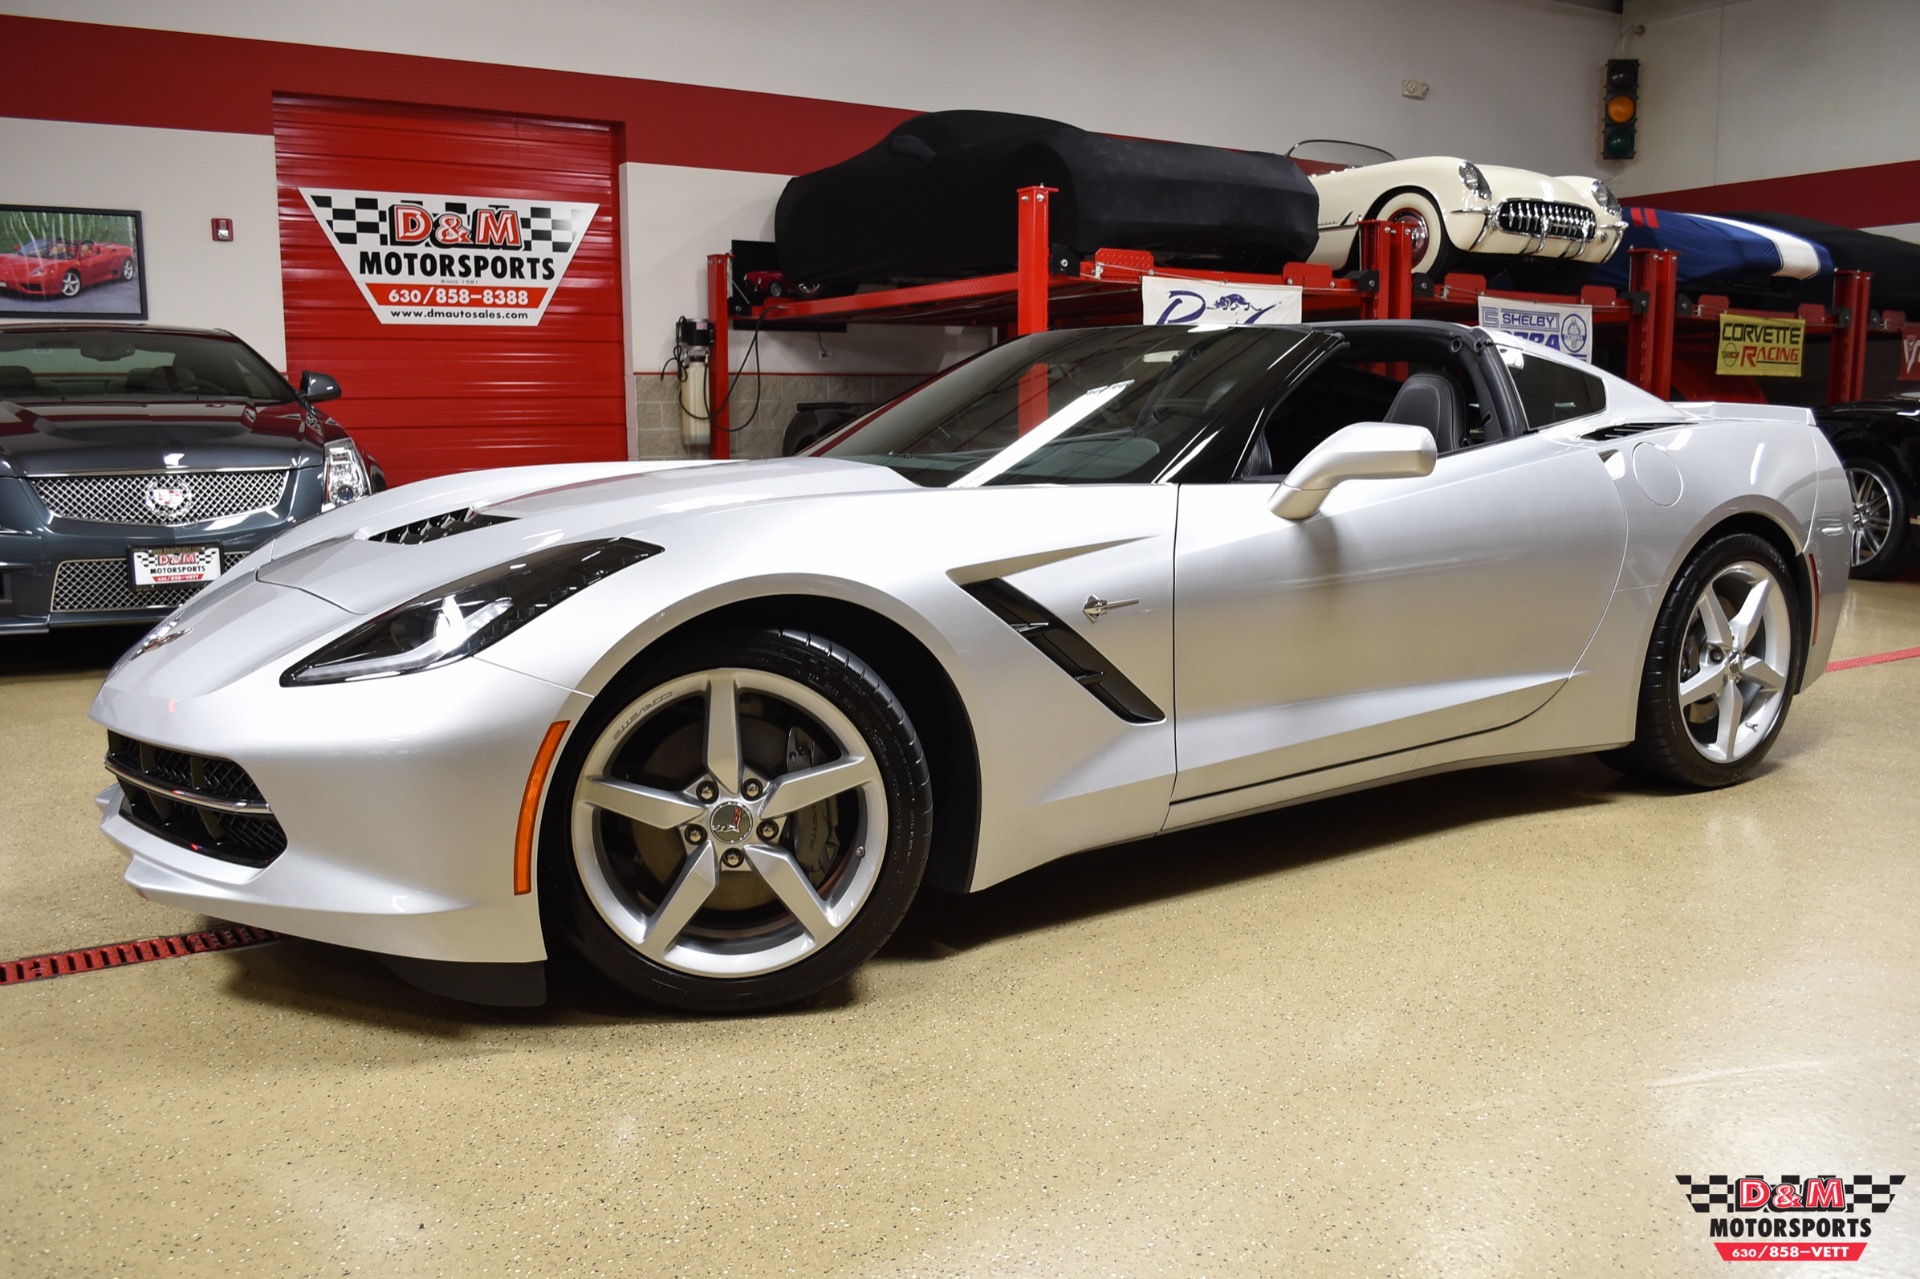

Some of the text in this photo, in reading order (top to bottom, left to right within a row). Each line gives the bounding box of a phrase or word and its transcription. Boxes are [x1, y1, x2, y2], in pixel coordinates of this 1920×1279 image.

[391, 204, 523, 250] D&M
[359, 251, 555, 281] MOTORSPORTS
[388, 287, 529, 305] 630/858-8388
[390, 308, 528, 320] www.dmautosales.com
[1502, 313, 1555, 328] SHELBY
[1722, 323, 1801, 345] CORVETTE
[1740, 345, 1799, 367] RACING
[150, 565, 206, 574] MOTORSPORTS
[158, 553, 197, 566] D&M
[612, 691, 673, 741] CORVETTE
